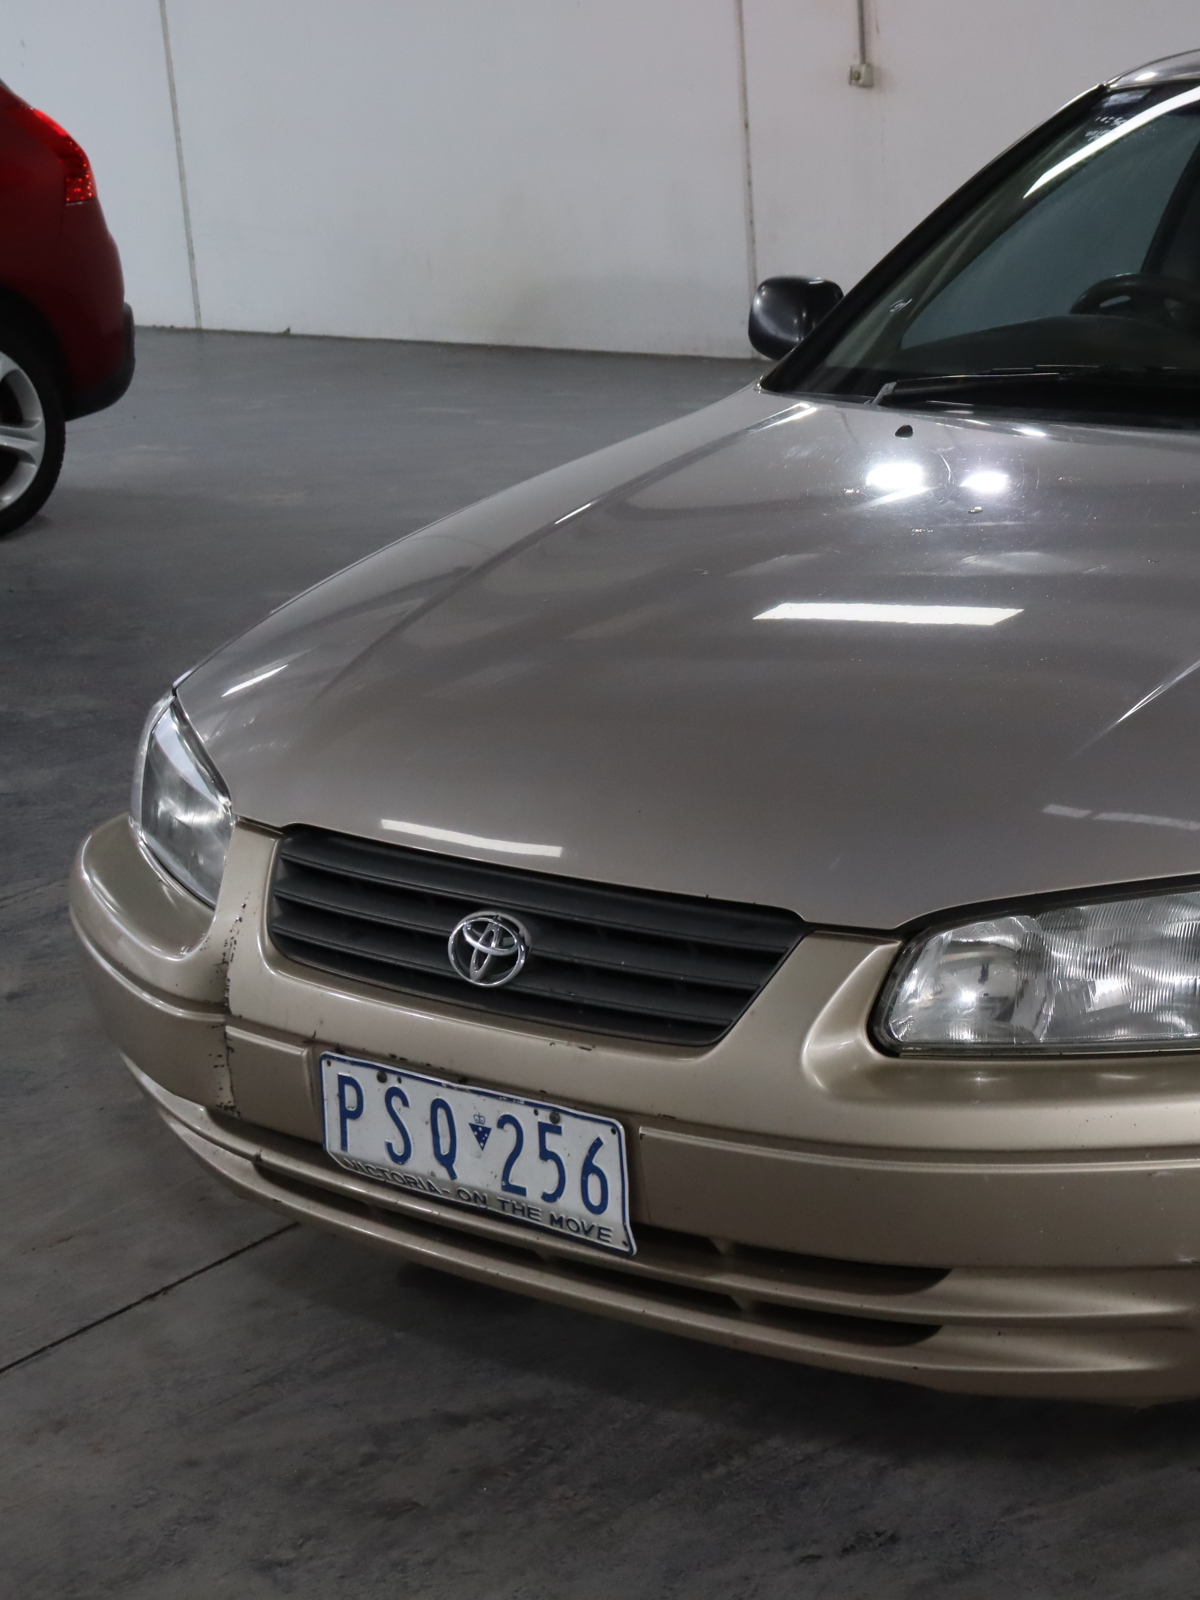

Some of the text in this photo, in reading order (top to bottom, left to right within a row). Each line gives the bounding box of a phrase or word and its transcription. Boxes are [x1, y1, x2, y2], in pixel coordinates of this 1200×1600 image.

[337, 1072, 609, 1215] PSQ 256
[457, 1187, 488, 1209] ON
[496, 1198, 542, 1221] THE
[549, 1212, 613, 1243] MOVE
